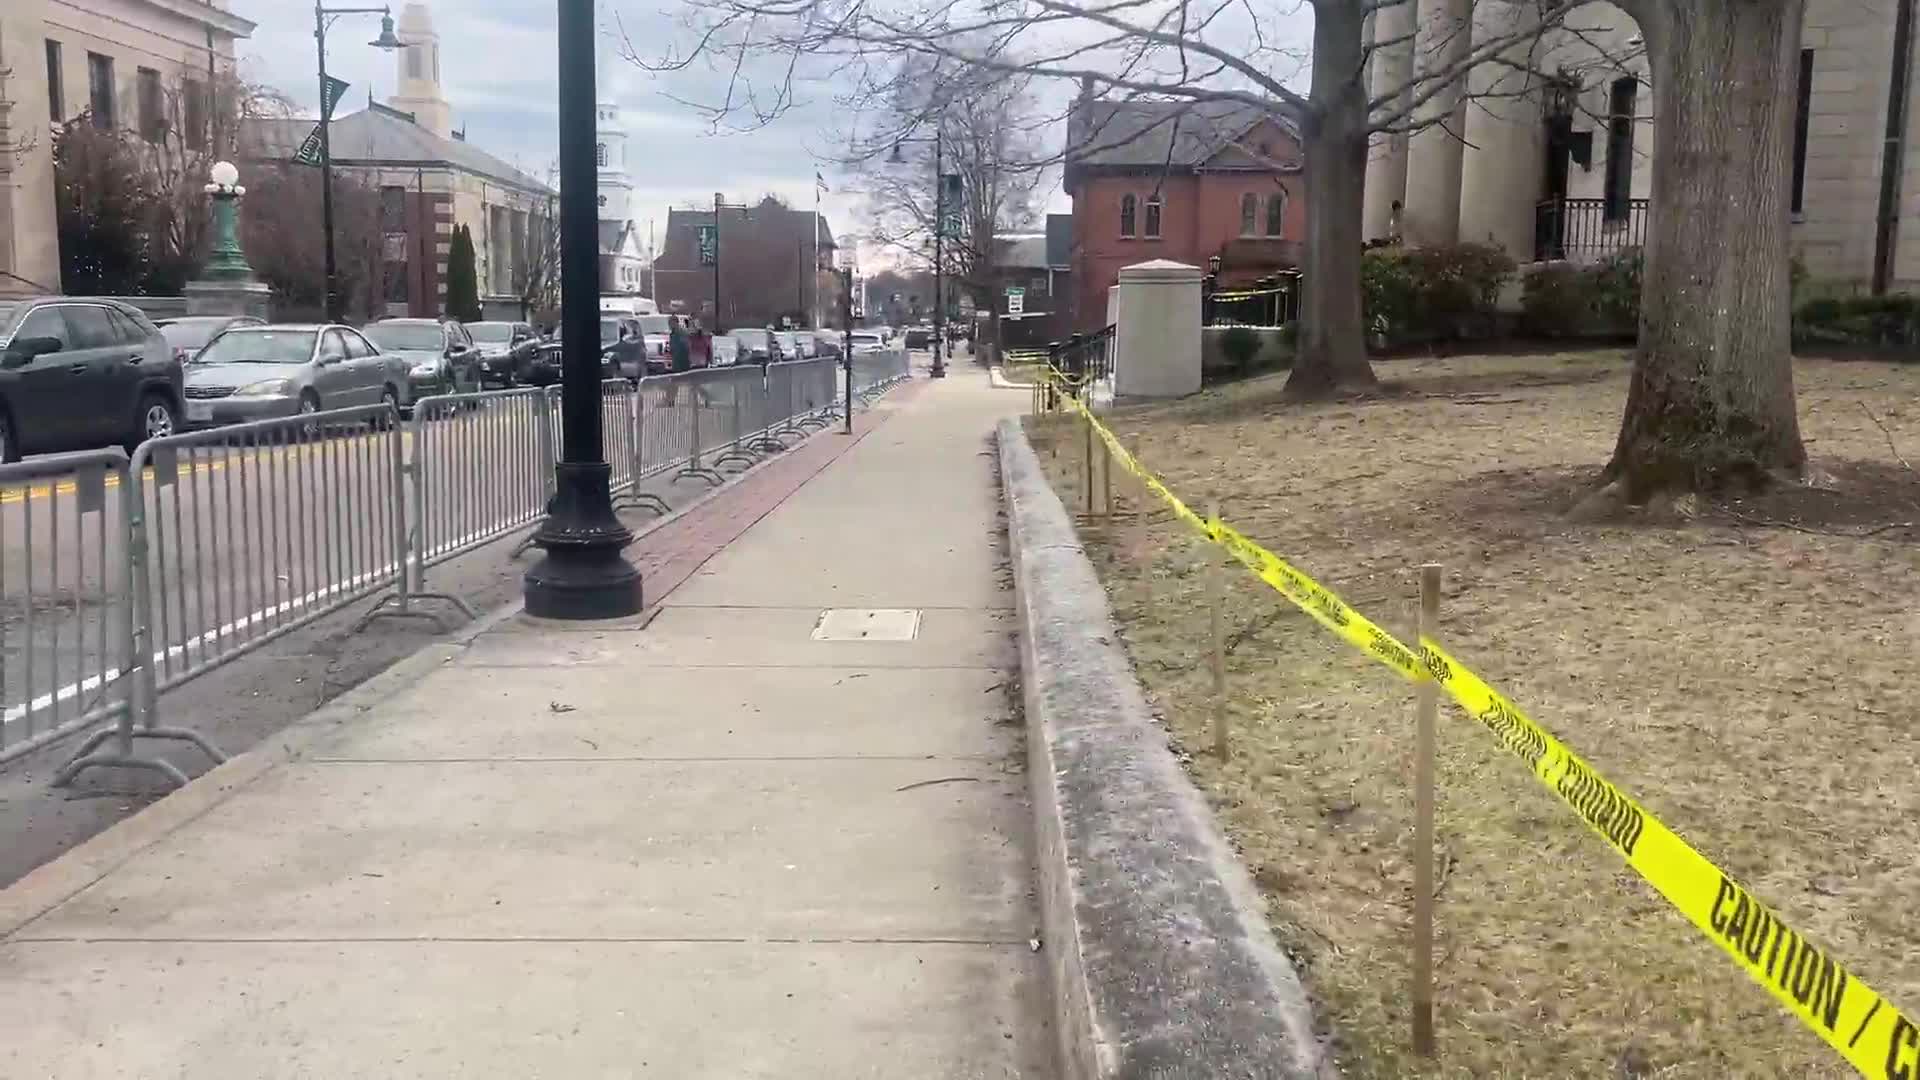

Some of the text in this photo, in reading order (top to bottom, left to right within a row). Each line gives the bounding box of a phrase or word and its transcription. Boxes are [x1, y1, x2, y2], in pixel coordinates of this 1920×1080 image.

[1711, 877, 1920, 1080] CAUTION / C
